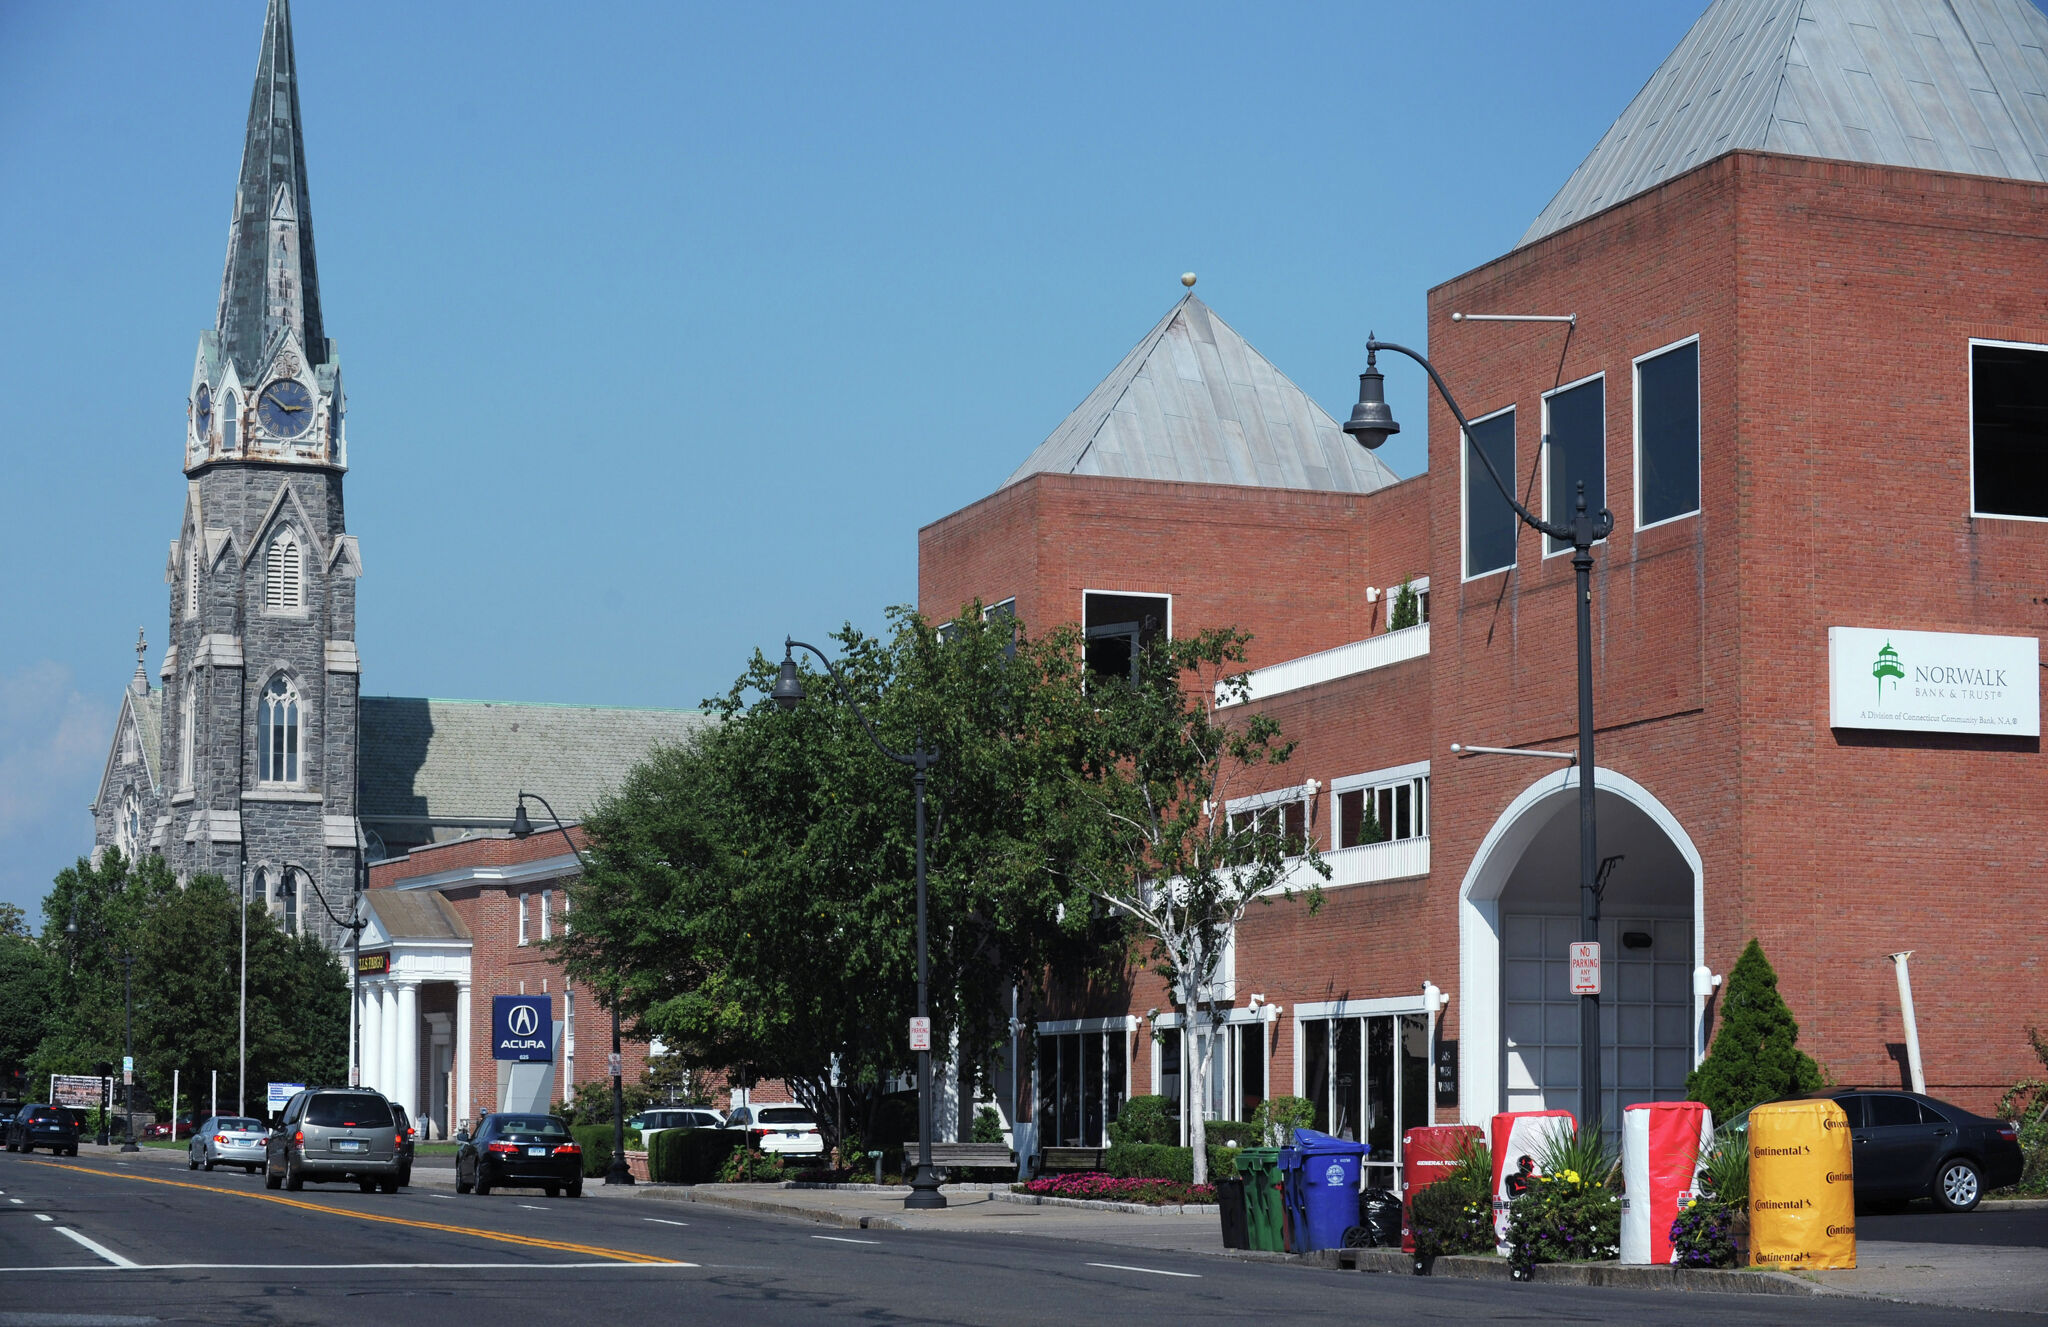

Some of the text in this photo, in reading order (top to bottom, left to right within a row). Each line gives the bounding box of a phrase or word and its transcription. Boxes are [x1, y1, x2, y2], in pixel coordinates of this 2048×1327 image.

[1915, 666, 2007, 687] NORWALK
[1915, 687, 1944, 698] BANK
[1949, 689, 1957, 699] &
[1860, 711, 1866, 719] A
[1868, 711, 1893, 720] Division
[1895, 711, 1902, 720] of
[1941, 714, 1977, 725] Community
[1580, 948, 1590, 957] NO
[1573, 959, 1597, 968] PARKING
[500, 1040, 546, 1049] ACURA
[1754, 1146, 1802, 1158] Continental
[1755, 1199, 1803, 1211] Continental
[1756, 1252, 1803, 1264] Continental
